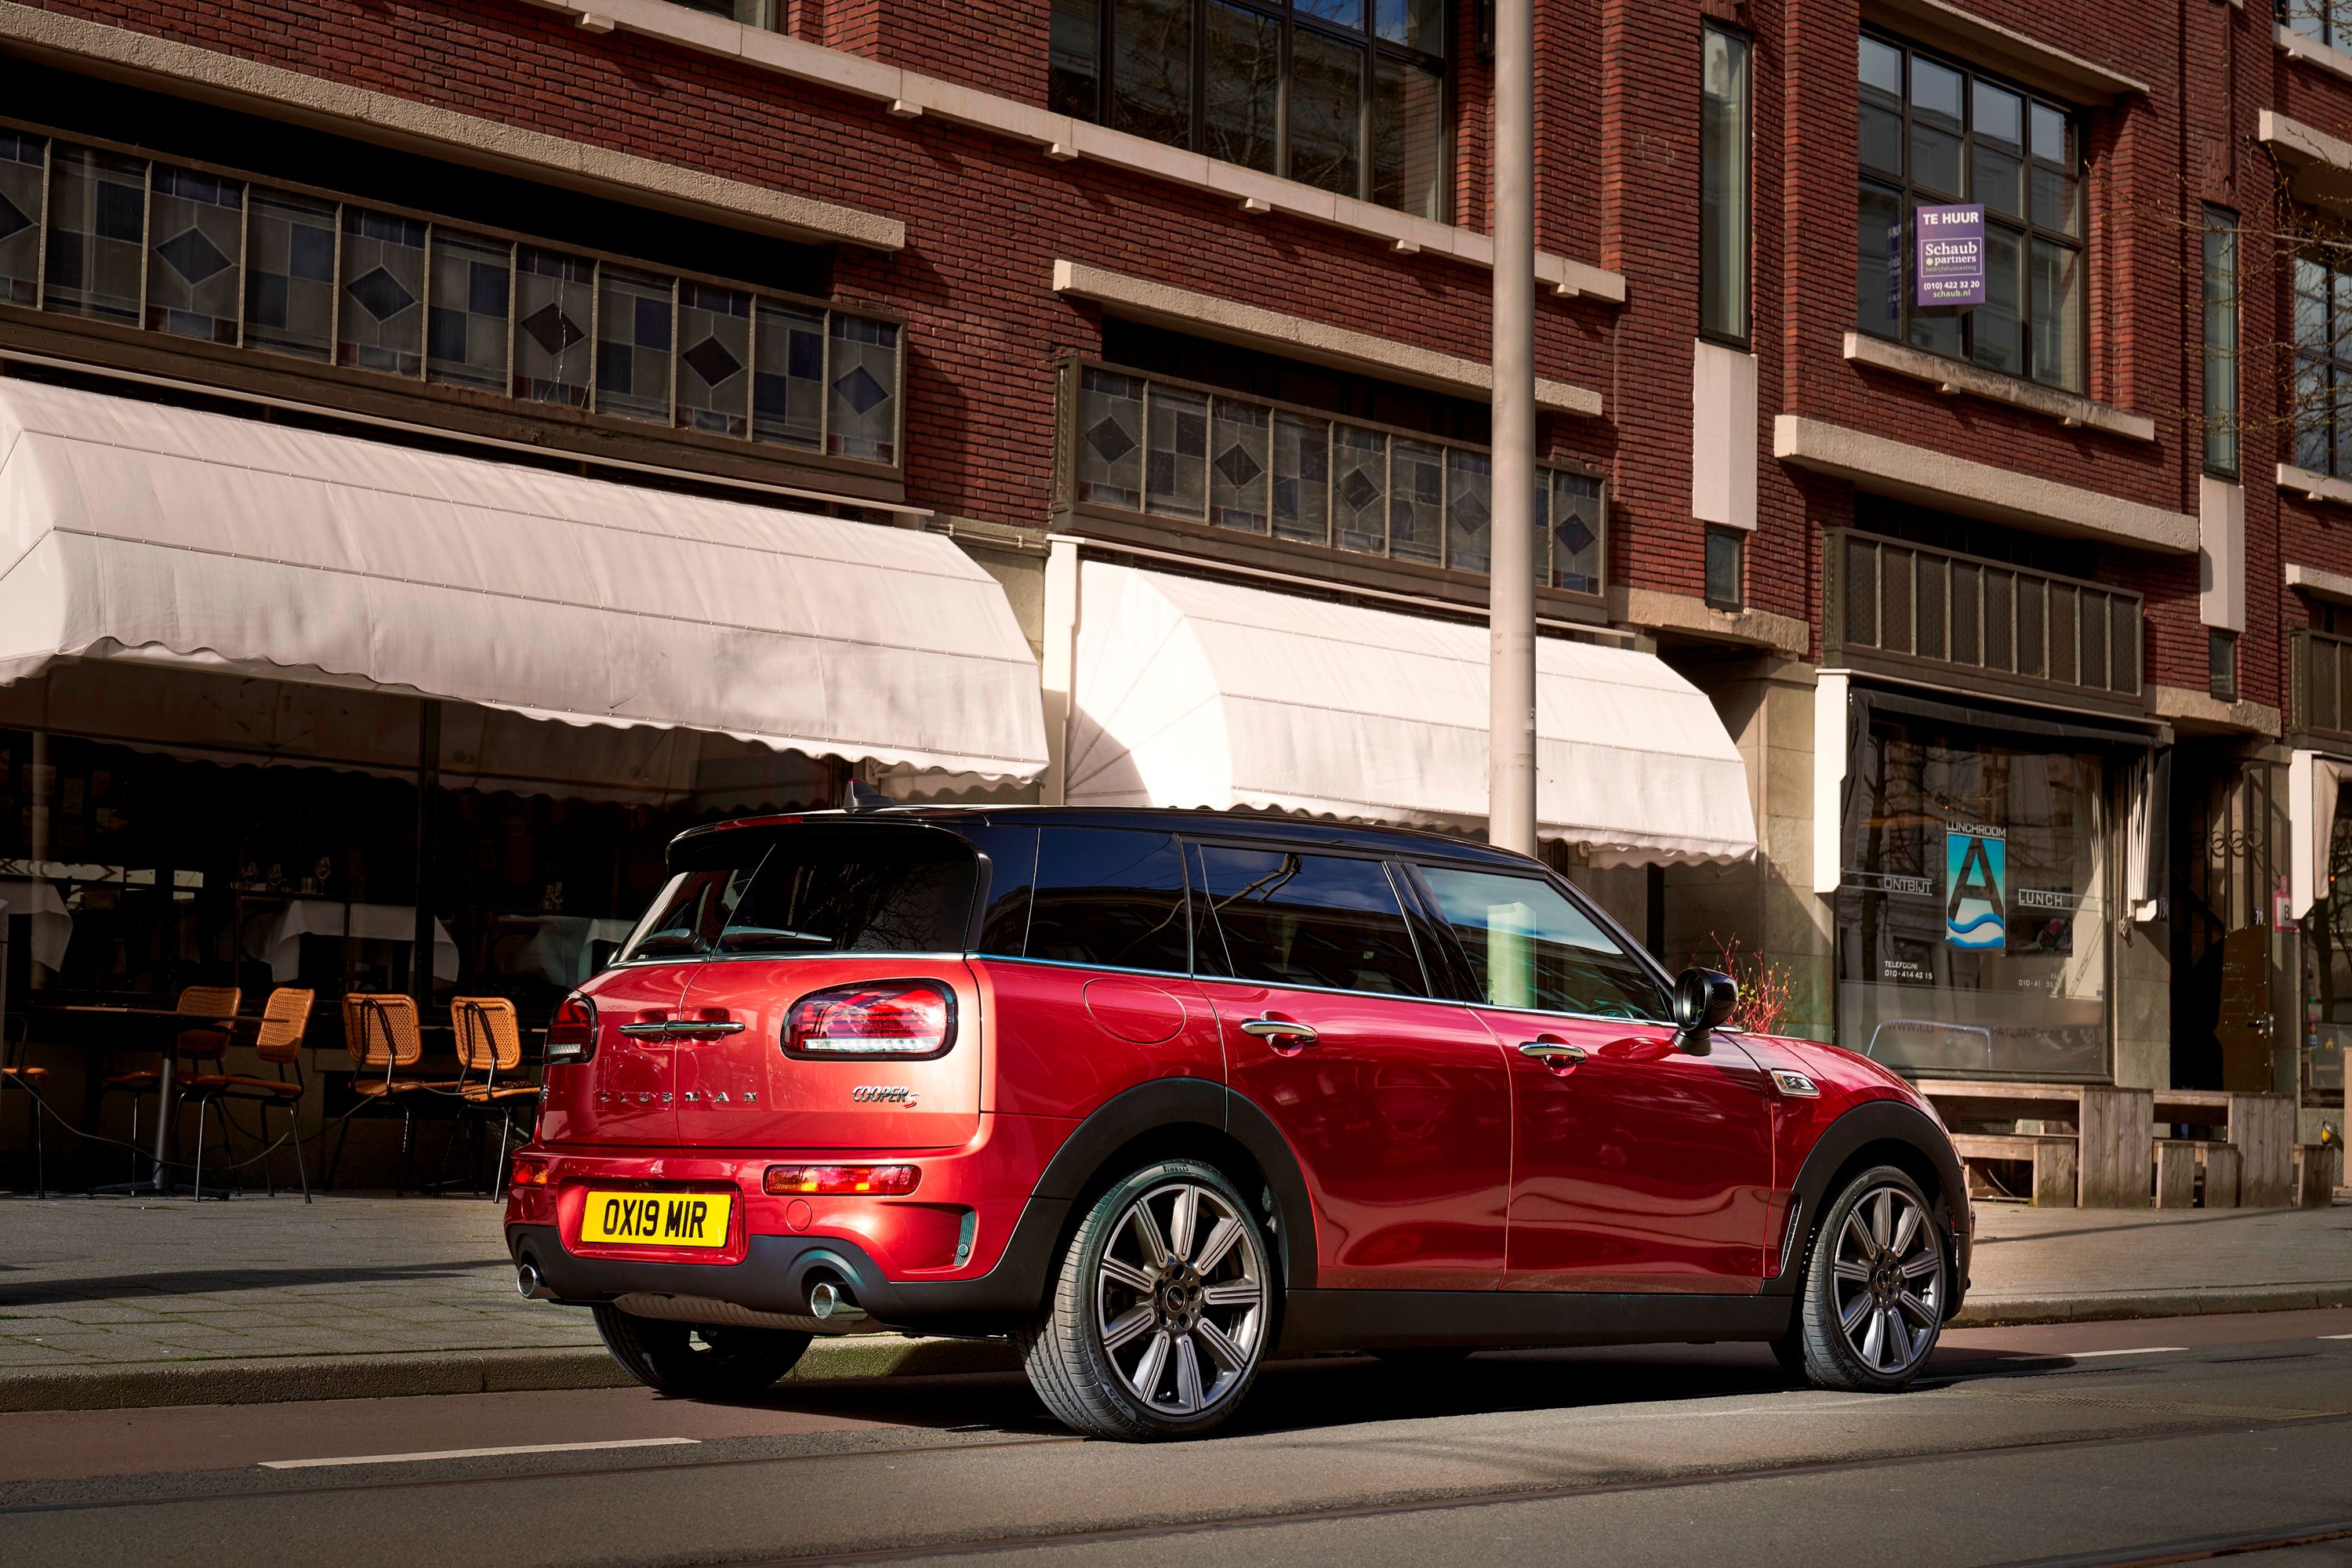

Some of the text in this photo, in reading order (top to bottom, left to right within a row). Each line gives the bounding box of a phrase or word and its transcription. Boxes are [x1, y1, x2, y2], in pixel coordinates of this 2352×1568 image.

[1922, 212, 1979, 225] TE HUUR
[1926, 241, 1977, 256] Schaub
[1934, 256, 1976, 267] partners
[1923, 281, 1943, 291] (010)
[1933, 289, 1971, 298] schaub.nl
[1946, 821, 2006, 838] LUNCHROOM
[1883, 877, 1931, 894] ONTBIJT
[2018, 891, 2063, 906] LUNCH
[600, 1091, 758, 1103] CLUBMAN
[852, 1085, 920, 1109] COOPER S
[1162, 1163, 1189, 1173] PIRELLI
[603, 1198, 707, 1239] OX19 MIR
